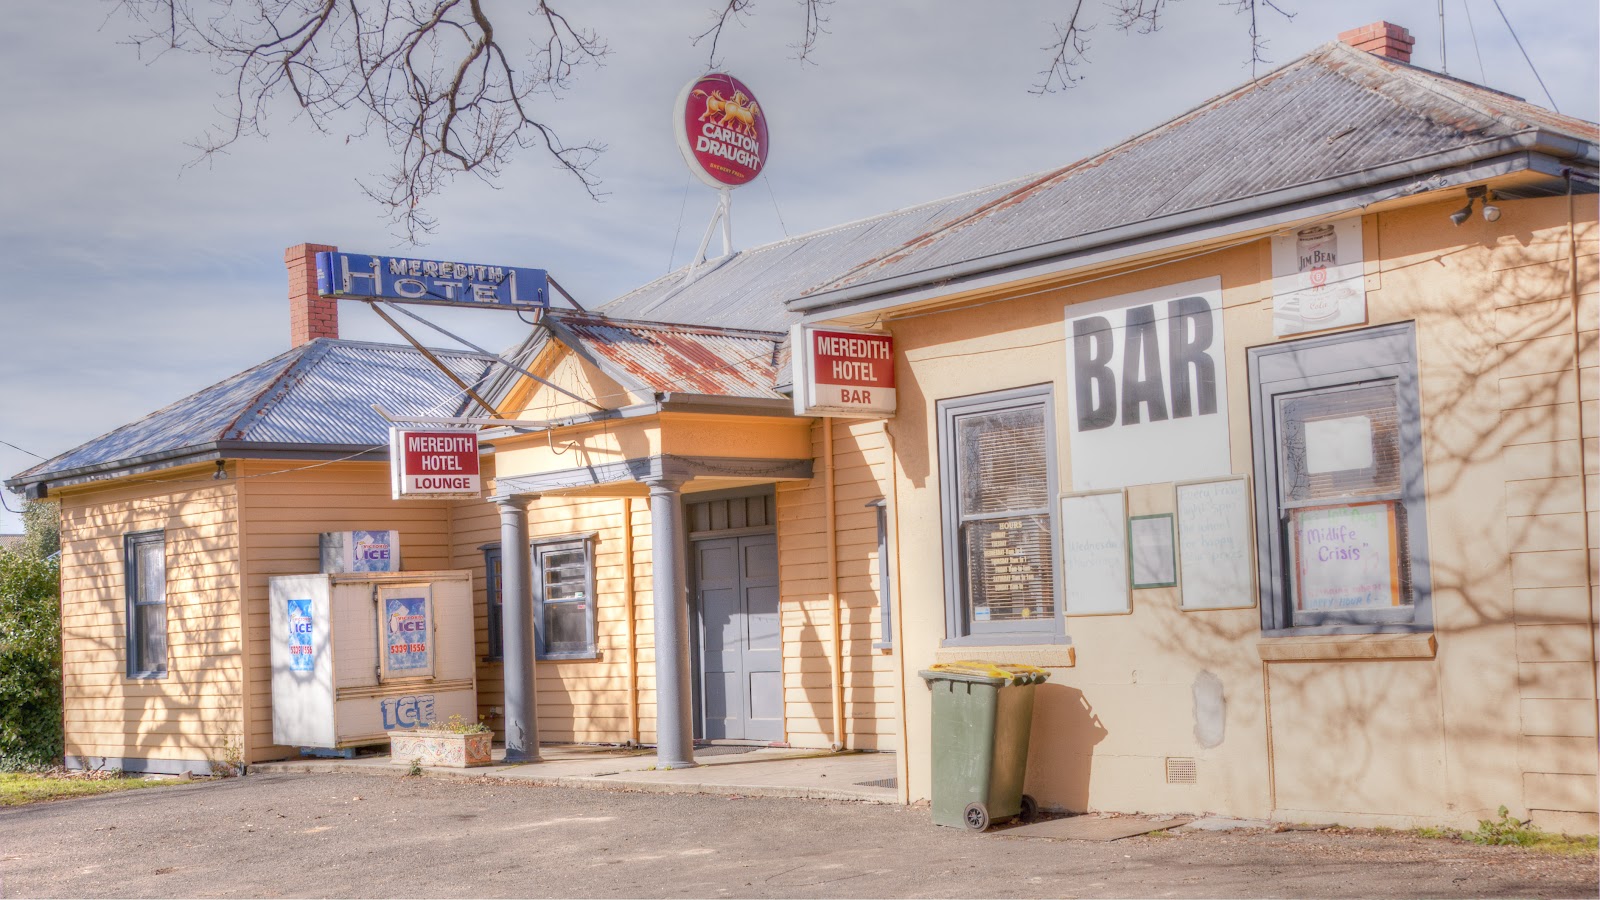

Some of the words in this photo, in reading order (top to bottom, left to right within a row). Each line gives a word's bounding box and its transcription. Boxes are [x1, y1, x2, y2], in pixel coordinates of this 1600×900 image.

[702, 123, 759, 156] CARLTON
[696, 136, 760, 170] DRAUGHT
[389, 258, 504, 283] MEREDITH
[1299, 255, 1312, 272] JIM
[1314, 250, 1336, 265] BEAM
[341, 255, 544, 306] HOTEL
[817, 336, 890, 360] MEREDITH
[832, 360, 878, 382] HOTEL
[1073, 296, 1217, 432] BAR
[841, 389, 871, 404] BAR
[408, 437, 474, 452] MEREDITH
[421, 455, 463, 471] HOTEL
[415, 477, 471, 489] LOUNGE
[999, 521, 1023, 530] HOURS
[364, 550, 389, 560] ICE
[295, 623, 312, 633] ICE
[399, 621, 425, 632] ICE
[391, 644, 408, 654] 5339
[410, 643, 426, 652] 1556
[381, 695, 436, 730] ICE
